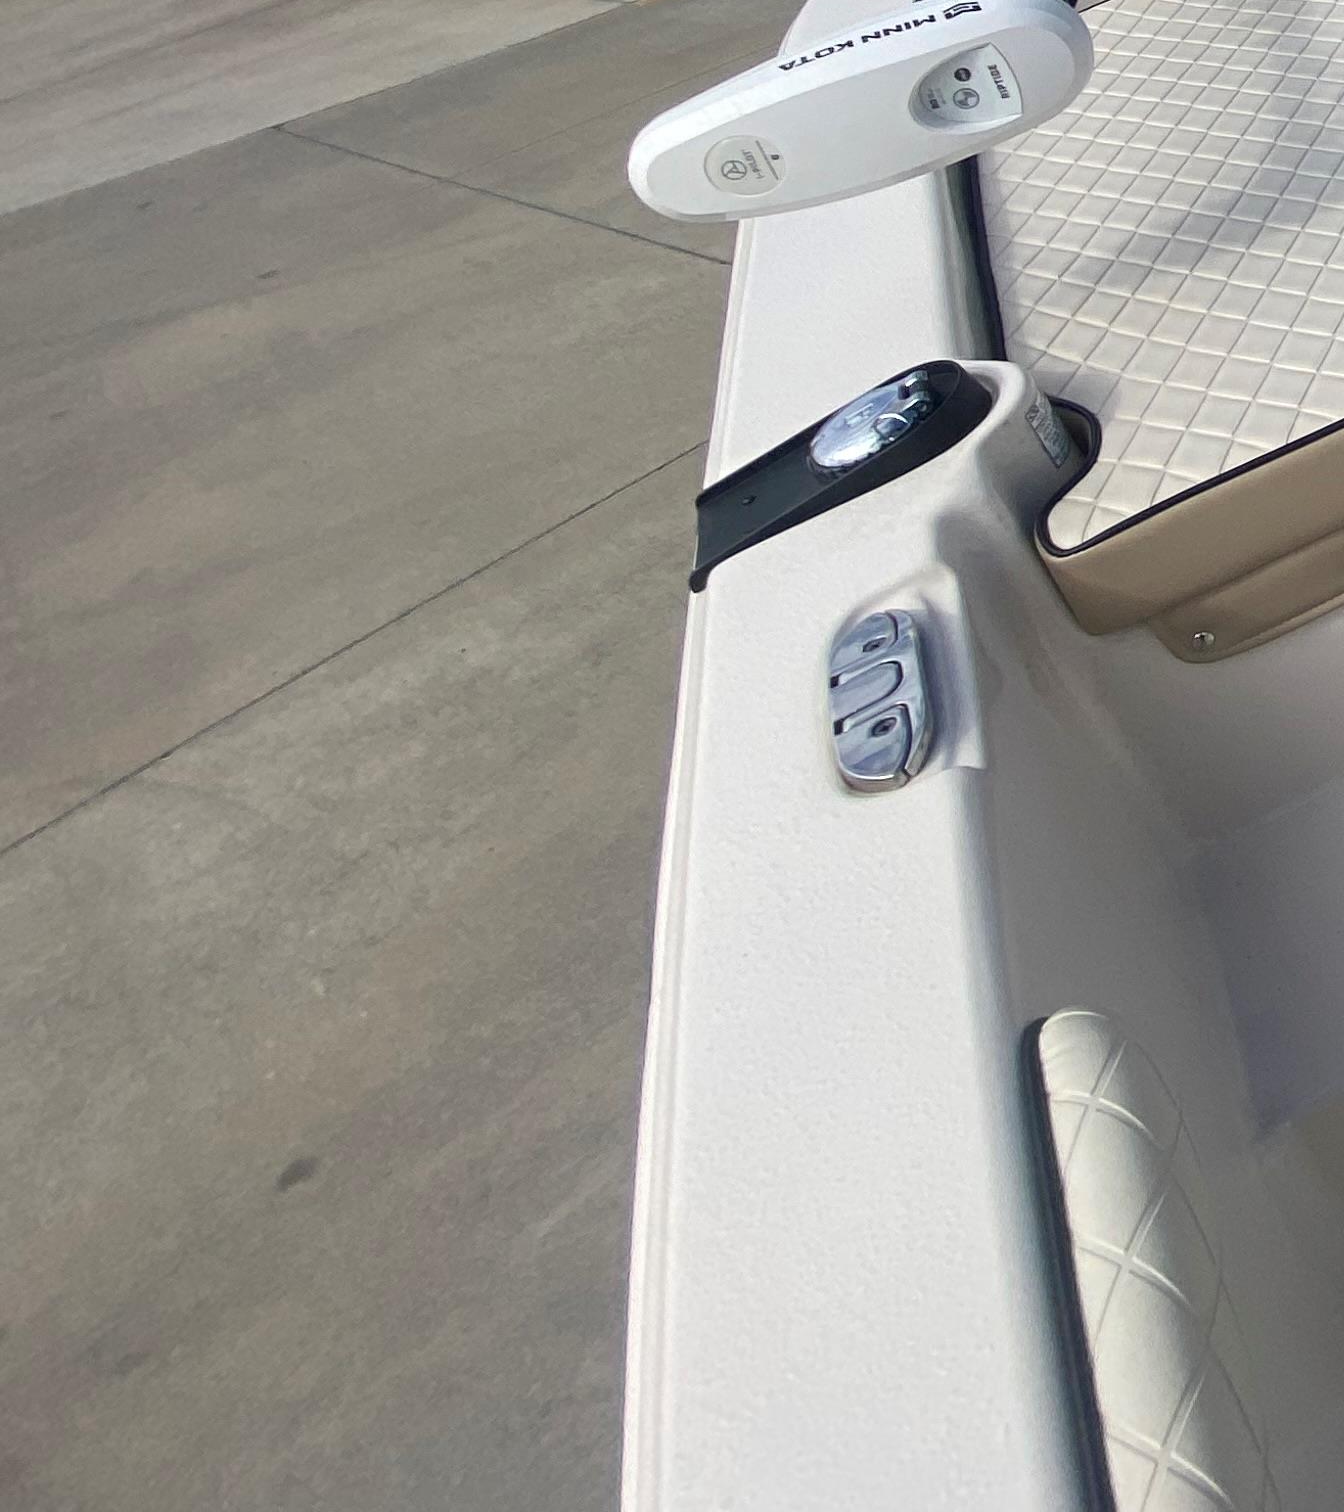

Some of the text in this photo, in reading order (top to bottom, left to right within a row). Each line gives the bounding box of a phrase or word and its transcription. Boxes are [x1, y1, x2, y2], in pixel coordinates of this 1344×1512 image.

[778, 14, 936, 71] MINN KOTA
[987, 64, 1010, 99] RIPTIDE
